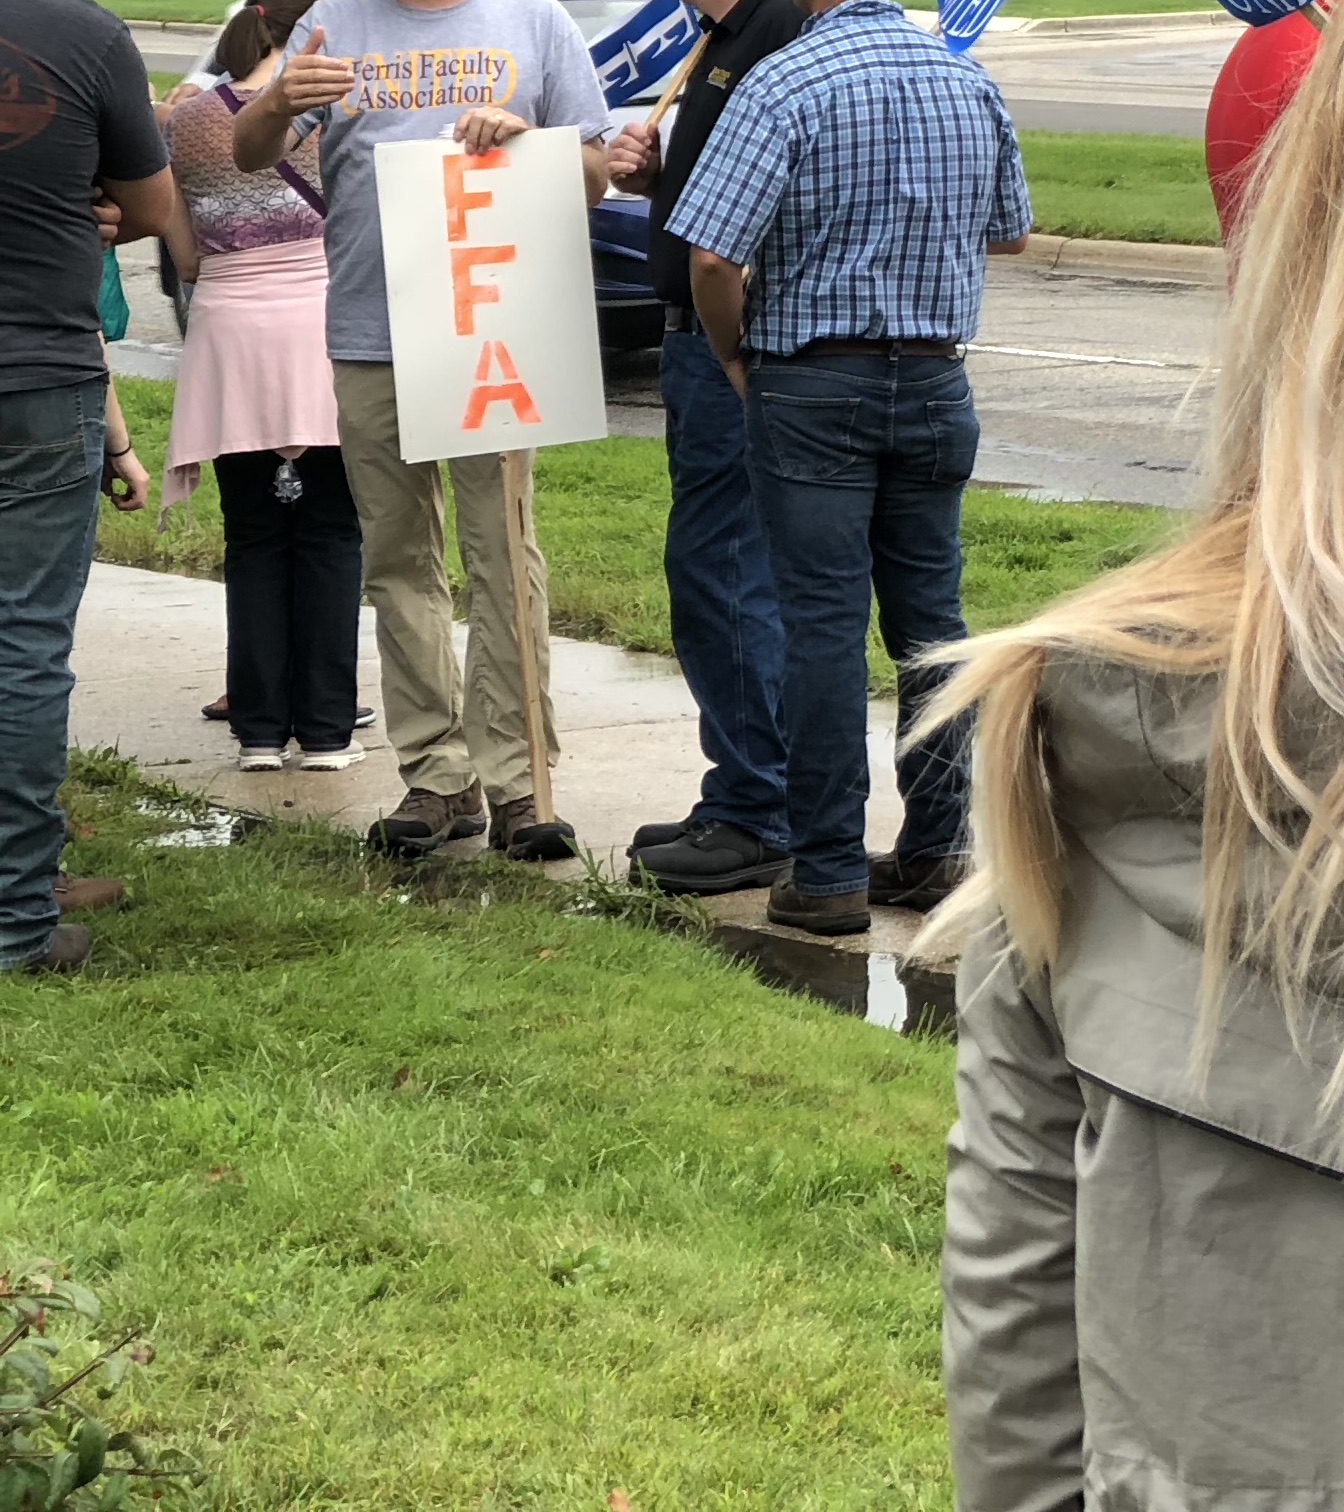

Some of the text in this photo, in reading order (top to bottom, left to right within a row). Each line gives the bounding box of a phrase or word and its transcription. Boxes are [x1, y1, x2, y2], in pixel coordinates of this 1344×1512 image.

[419, 50, 507, 83] Faculty
[595, 0, 696, 91] FF
[356, 78, 493, 111] Association
[442, 148, 542, 431] FFA
